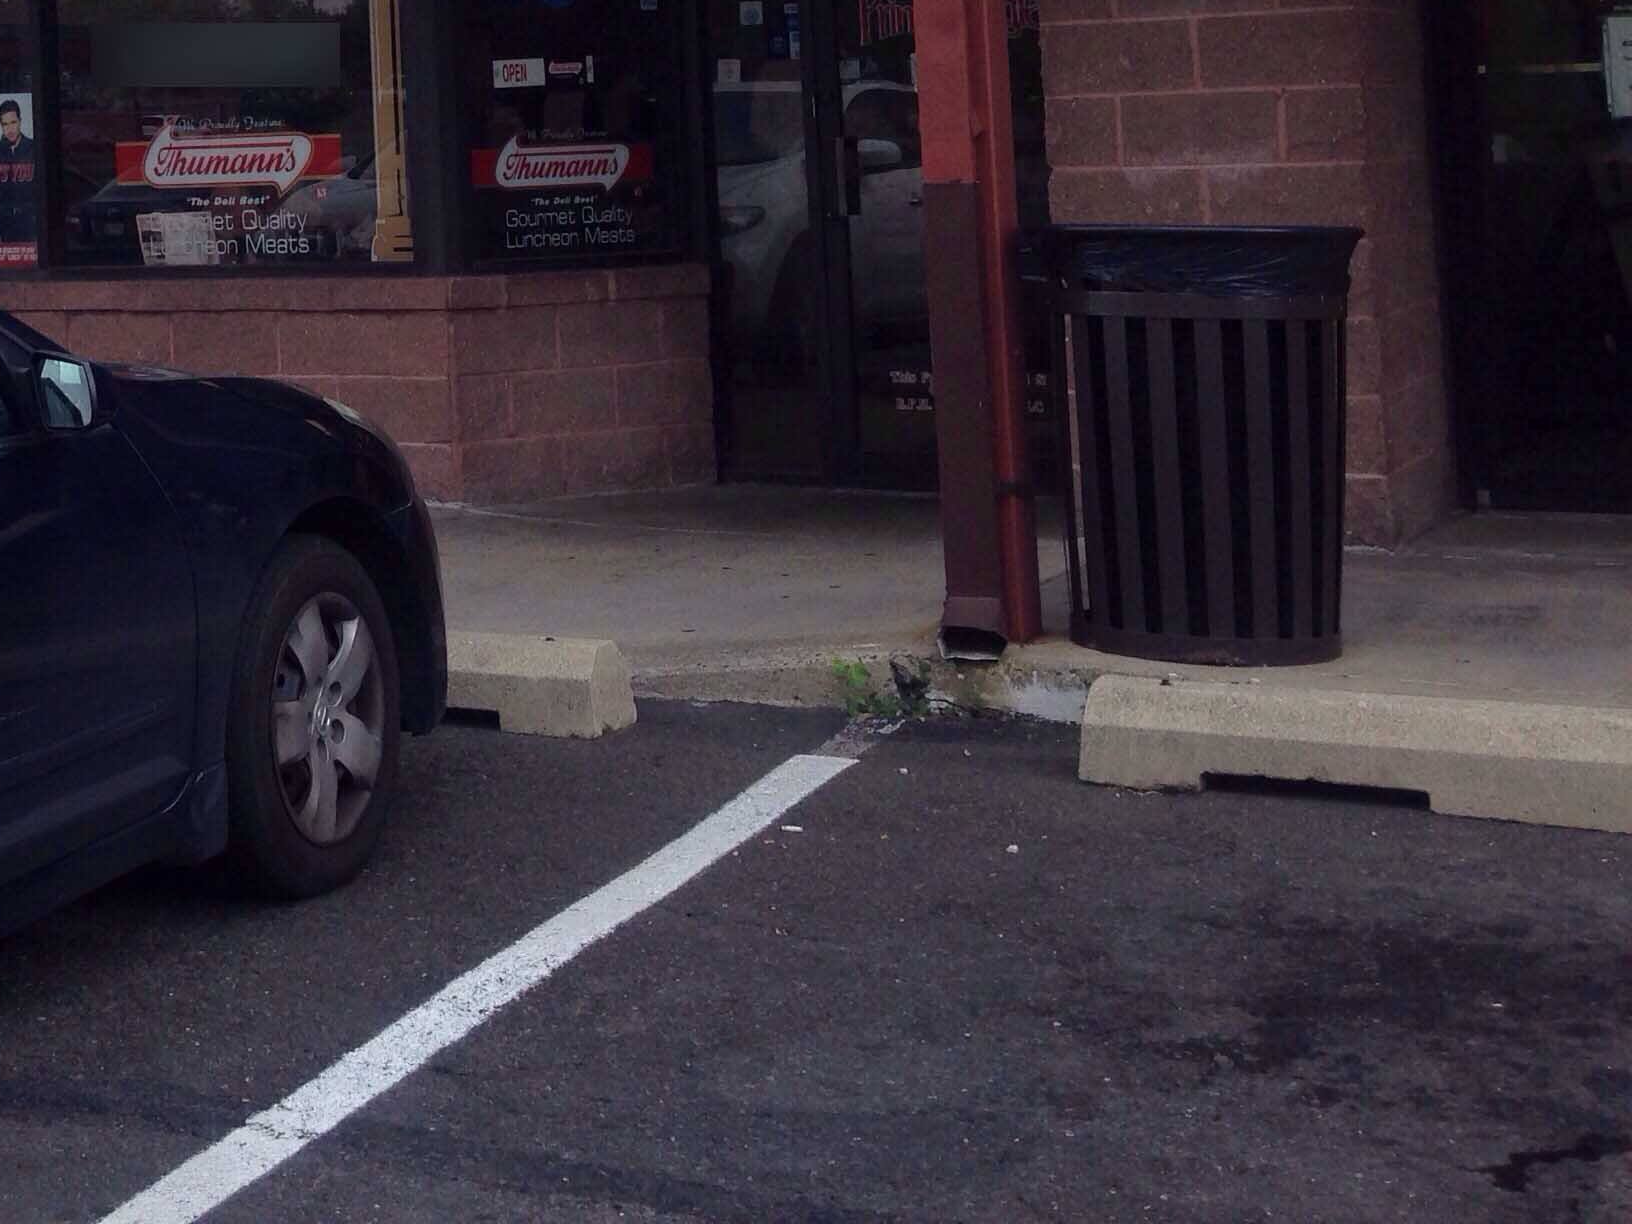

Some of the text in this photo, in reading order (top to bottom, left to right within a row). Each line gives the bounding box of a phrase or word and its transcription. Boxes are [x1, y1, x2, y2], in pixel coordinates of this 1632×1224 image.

[502, 63, 527, 82] OPEN
[154, 143, 296, 176] Thumann's
[242, 209, 308, 234] Quality
[506, 204, 633, 227] Gourmet Quality
[246, 233, 310, 255] Meats
[506, 230, 579, 249] Luncheon
